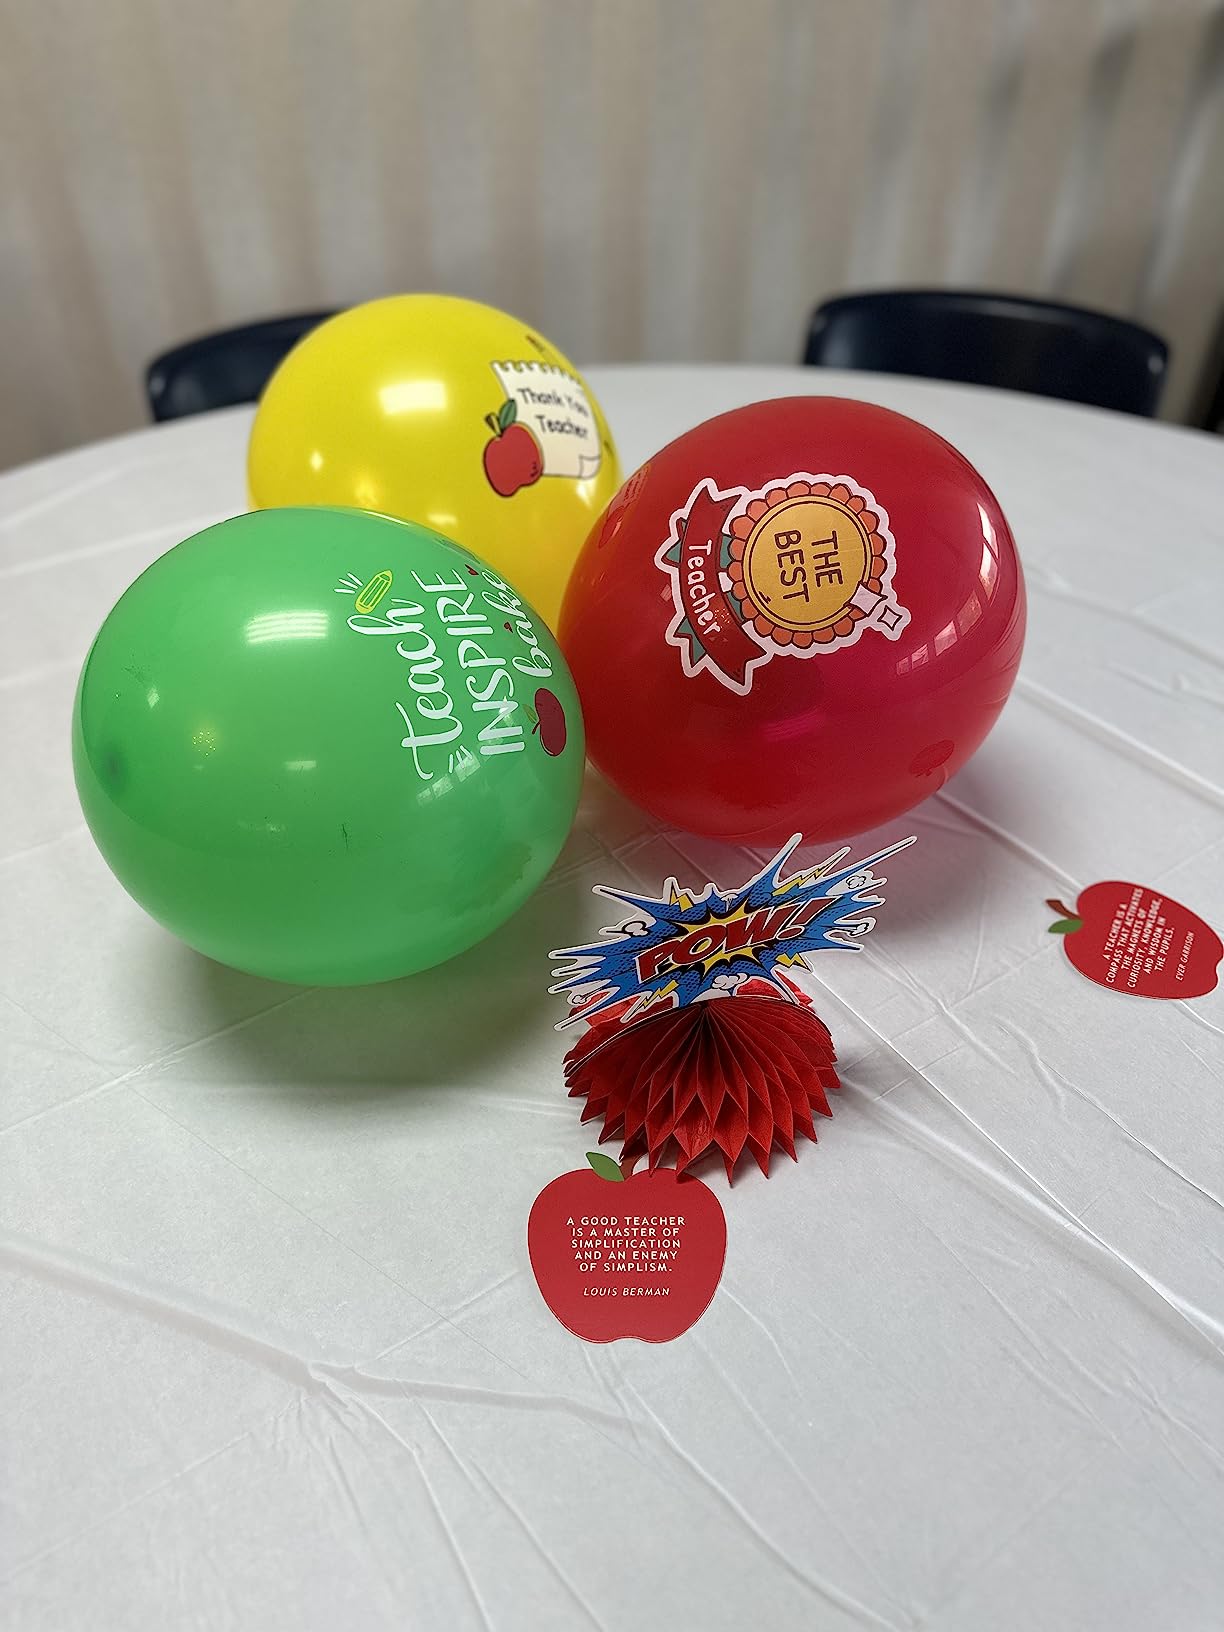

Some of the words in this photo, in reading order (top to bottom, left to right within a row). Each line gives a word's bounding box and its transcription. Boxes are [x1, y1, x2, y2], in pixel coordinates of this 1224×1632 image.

[516, 387, 565, 407] Thank
[535, 414, 588, 438] Teacher
[774, 529, 810, 603] BEST
[811, 530, 843, 588] THE
[687, 539, 723, 635] Teacher
[410, 568, 525, 756] INSPIRE
[1104, 919, 1122, 952] TEACHER
[1116, 910, 1125, 919] IS
[1156, 916, 1166, 926] IN
[633, 897, 836, 984] POW!
[1105, 948, 1124, 983] COMPASS
[1116, 927, 1130, 947] THAT
[1124, 887, 1144, 927] ACTIVATES
[1121, 955, 1132, 970] THE
[1127, 919, 1144, 955] MAGNETS
[1137, 908, 1147, 919] OF
[1148, 927, 1163, 956] WISDOM
[1159, 927, 1175, 955] PUPILS.
[1180, 931, 1195, 963] GARRISON
[1143, 957, 1154, 974] AND
[1154, 955, 1166, 971] THE
[1175, 962, 1188, 981] EVER
[566, 1217, 574, 1226] A
[581, 1216, 618, 1226] GOOD
[624, 1216, 685, 1226] TEACHER
[572, 1228, 583, 1237] IS
[590, 1228, 597, 1237] A
[604, 1228, 656, 1237] MASTER
[662, 1228, 680, 1237] OF
[571, 1239, 681, 1248] SIMPLIFICATION
[575, 1251, 601, 1260] AND
[608, 1251, 626, 1260] AN
[632, 1251, 678, 1260] ENEMY
[579, 1262, 597, 1272] OF
[604, 1262, 672, 1272] SIMPLISM.
[583, 1287, 618, 1296] LOUIS
[622, 1287, 670, 1296] BERMAN
